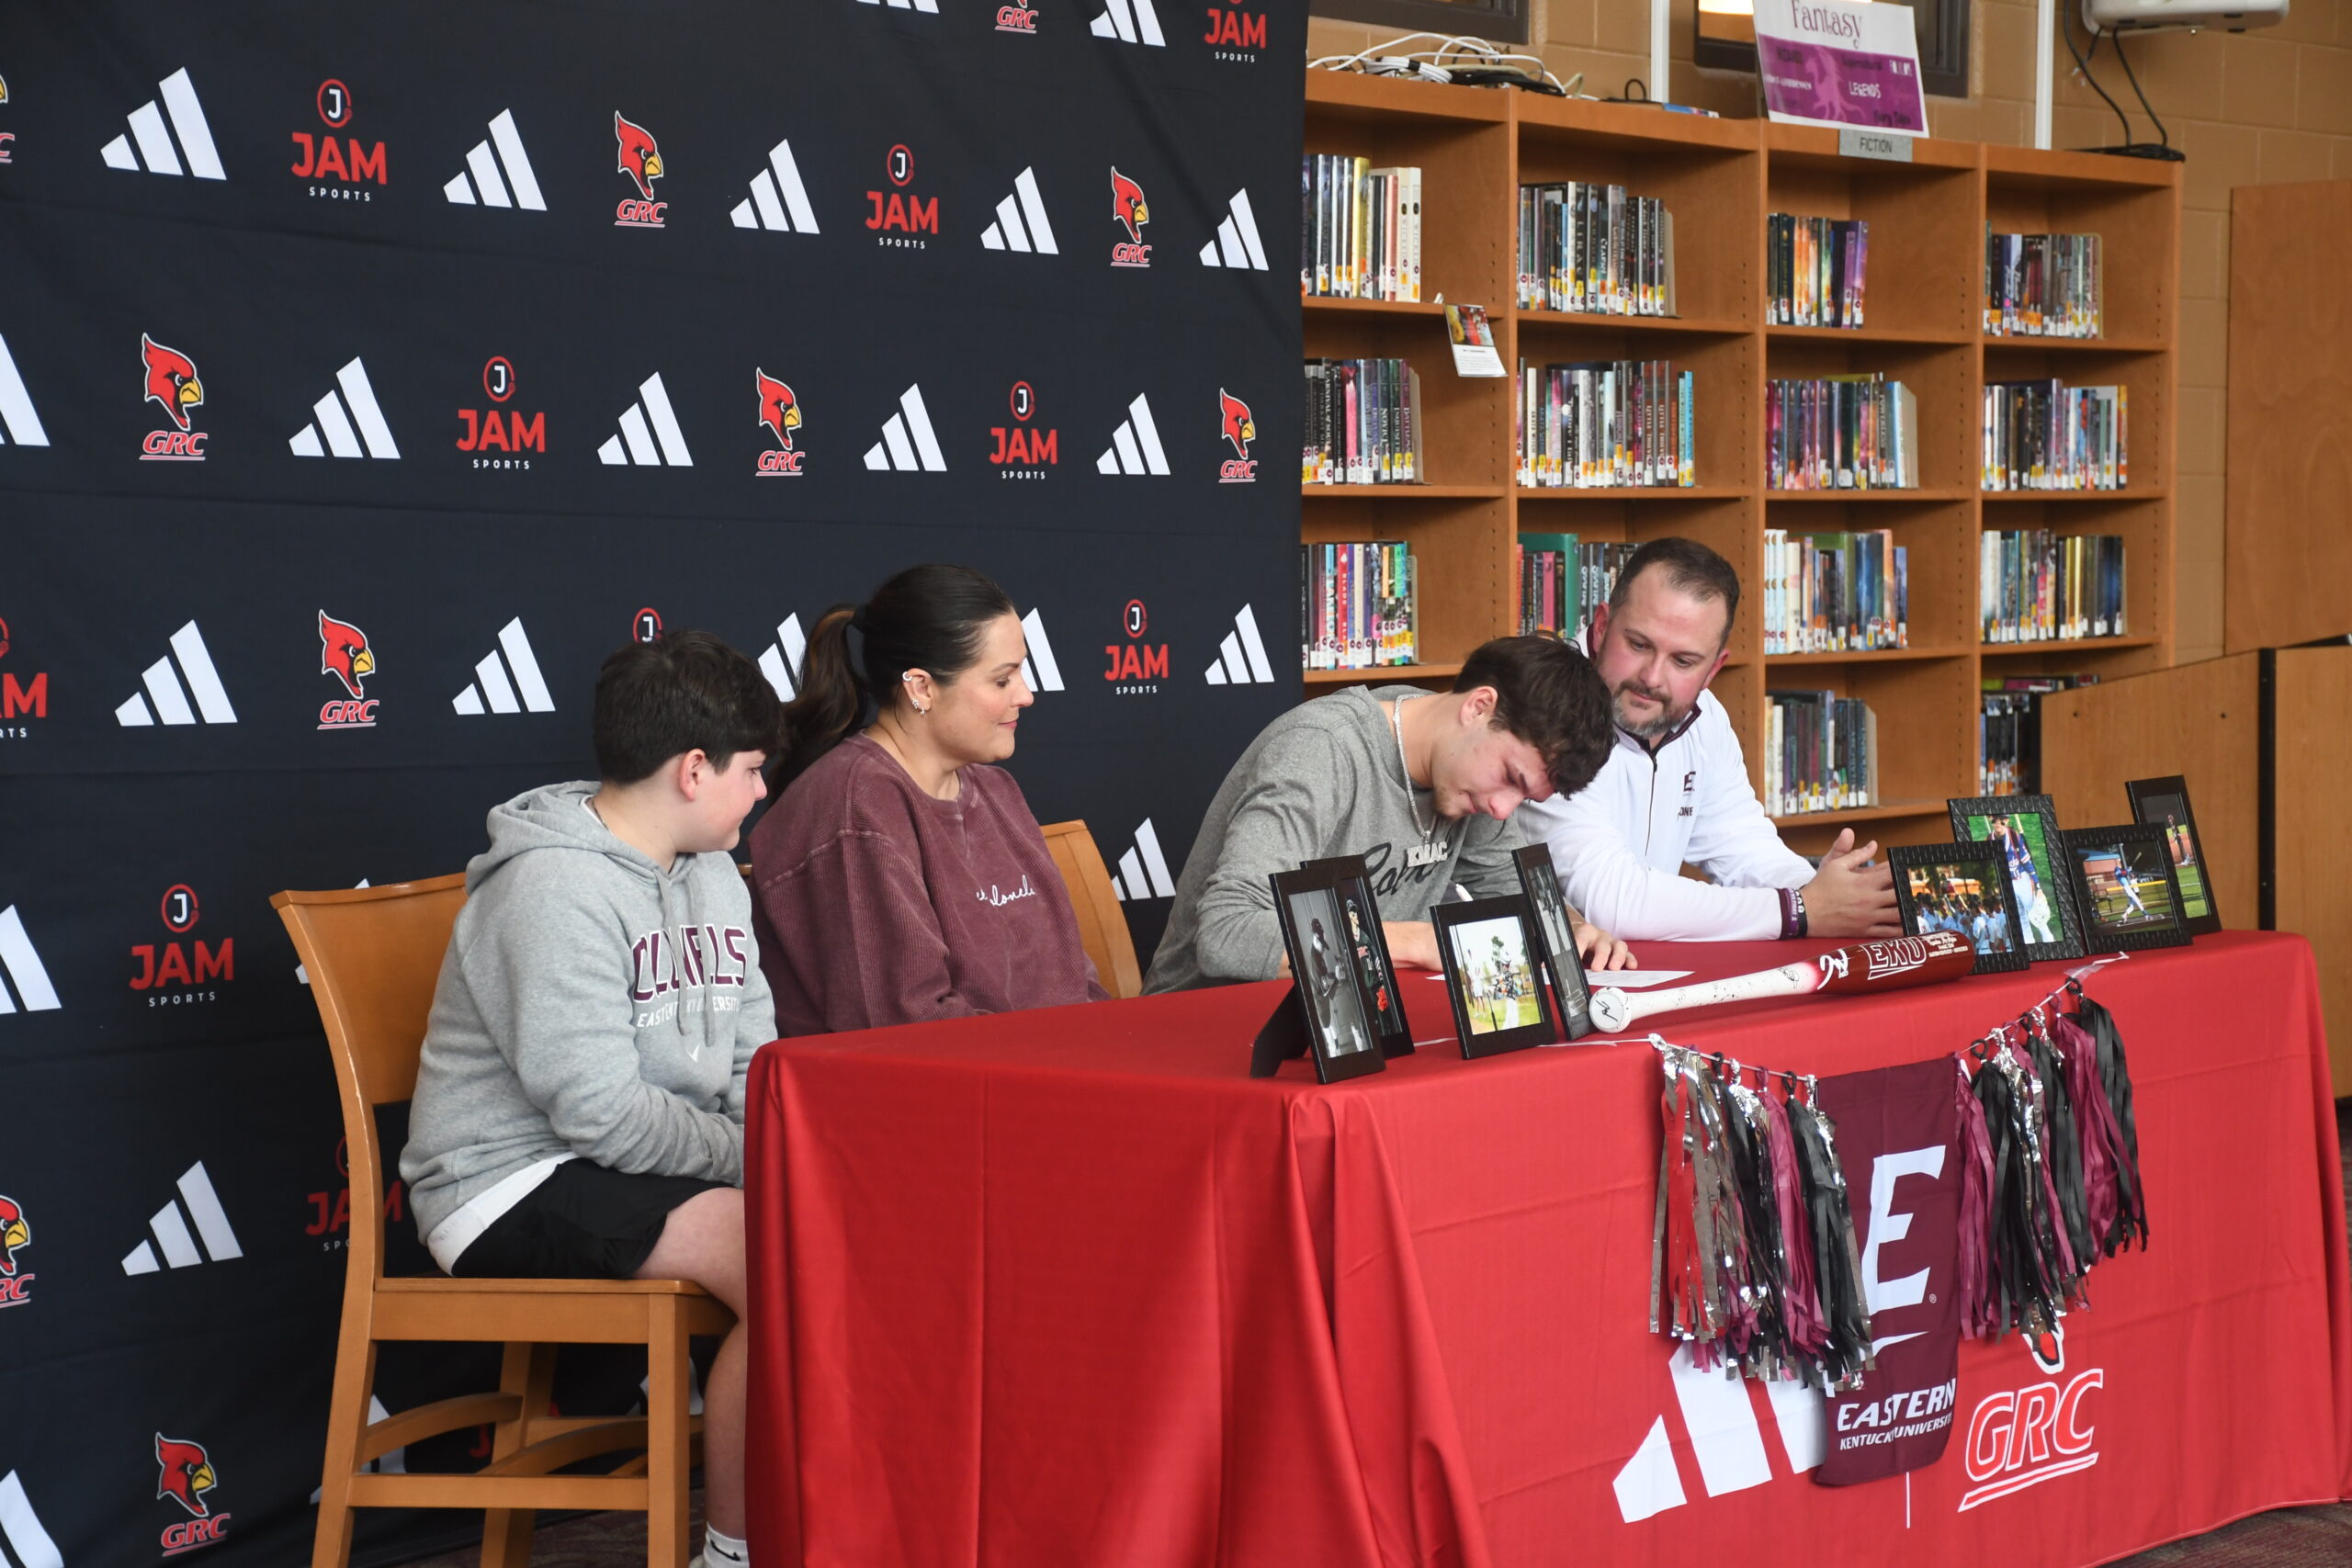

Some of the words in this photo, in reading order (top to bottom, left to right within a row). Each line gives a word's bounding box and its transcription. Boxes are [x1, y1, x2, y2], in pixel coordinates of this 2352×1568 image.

[997, 6, 1039, 28] GRC
[1204, 8, 1267, 49] JAM
[1792, 0, 1862, 49] Fantasy
[1215, 51, 1255, 63] SPORTS
[1849, 81, 1882, 98] LEGENDS
[327, 89, 341, 119] J
[1860, 137, 1893, 153] FICTION
[290, 132, 388, 185] JAM
[895, 152, 906, 178] J
[309, 186, 371, 202] SPORTS
[616, 199, 668, 223] GRC
[865, 191, 938, 235] JAM
[878, 237, 926, 250] SPORTS
[1112, 243, 1152, 264] GRC
[493, 365, 506, 394] J
[1017, 389, 1028, 414] J
[142, 430, 208, 456] GRC
[456, 409, 546, 453] JAM
[989, 427, 1057, 466] JAM
[472, 458, 530, 470] SPORTS
[758, 450, 805, 471] GRC
[1221, 459, 1258, 479] GRC
[1001, 470, 1046, 480] SPORTS
[642, 616, 653, 641] J
[1131, 606, 1140, 630] J
[1104, 644, 1169, 682] JAM
[1115, 685, 1158, 695] SPORTS
[320, 700, 379, 724] GRC
[1684, 771, 1696, 792] E
[1408, 841, 1448, 867] KMAC
[173, 894, 187, 924] J
[130, 938, 233, 990] JAM
[1860, 936, 1927, 969] EKU
[149, 991, 215, 1008] SPORTS
[1869, 1145, 1946, 1314] E
[0, 1273, 35, 1302] RC
[1838, 1378, 1956, 1432] EASTERN
[1965, 1368, 2104, 1483] GRC
[161, 1513, 230, 1549] GRC
